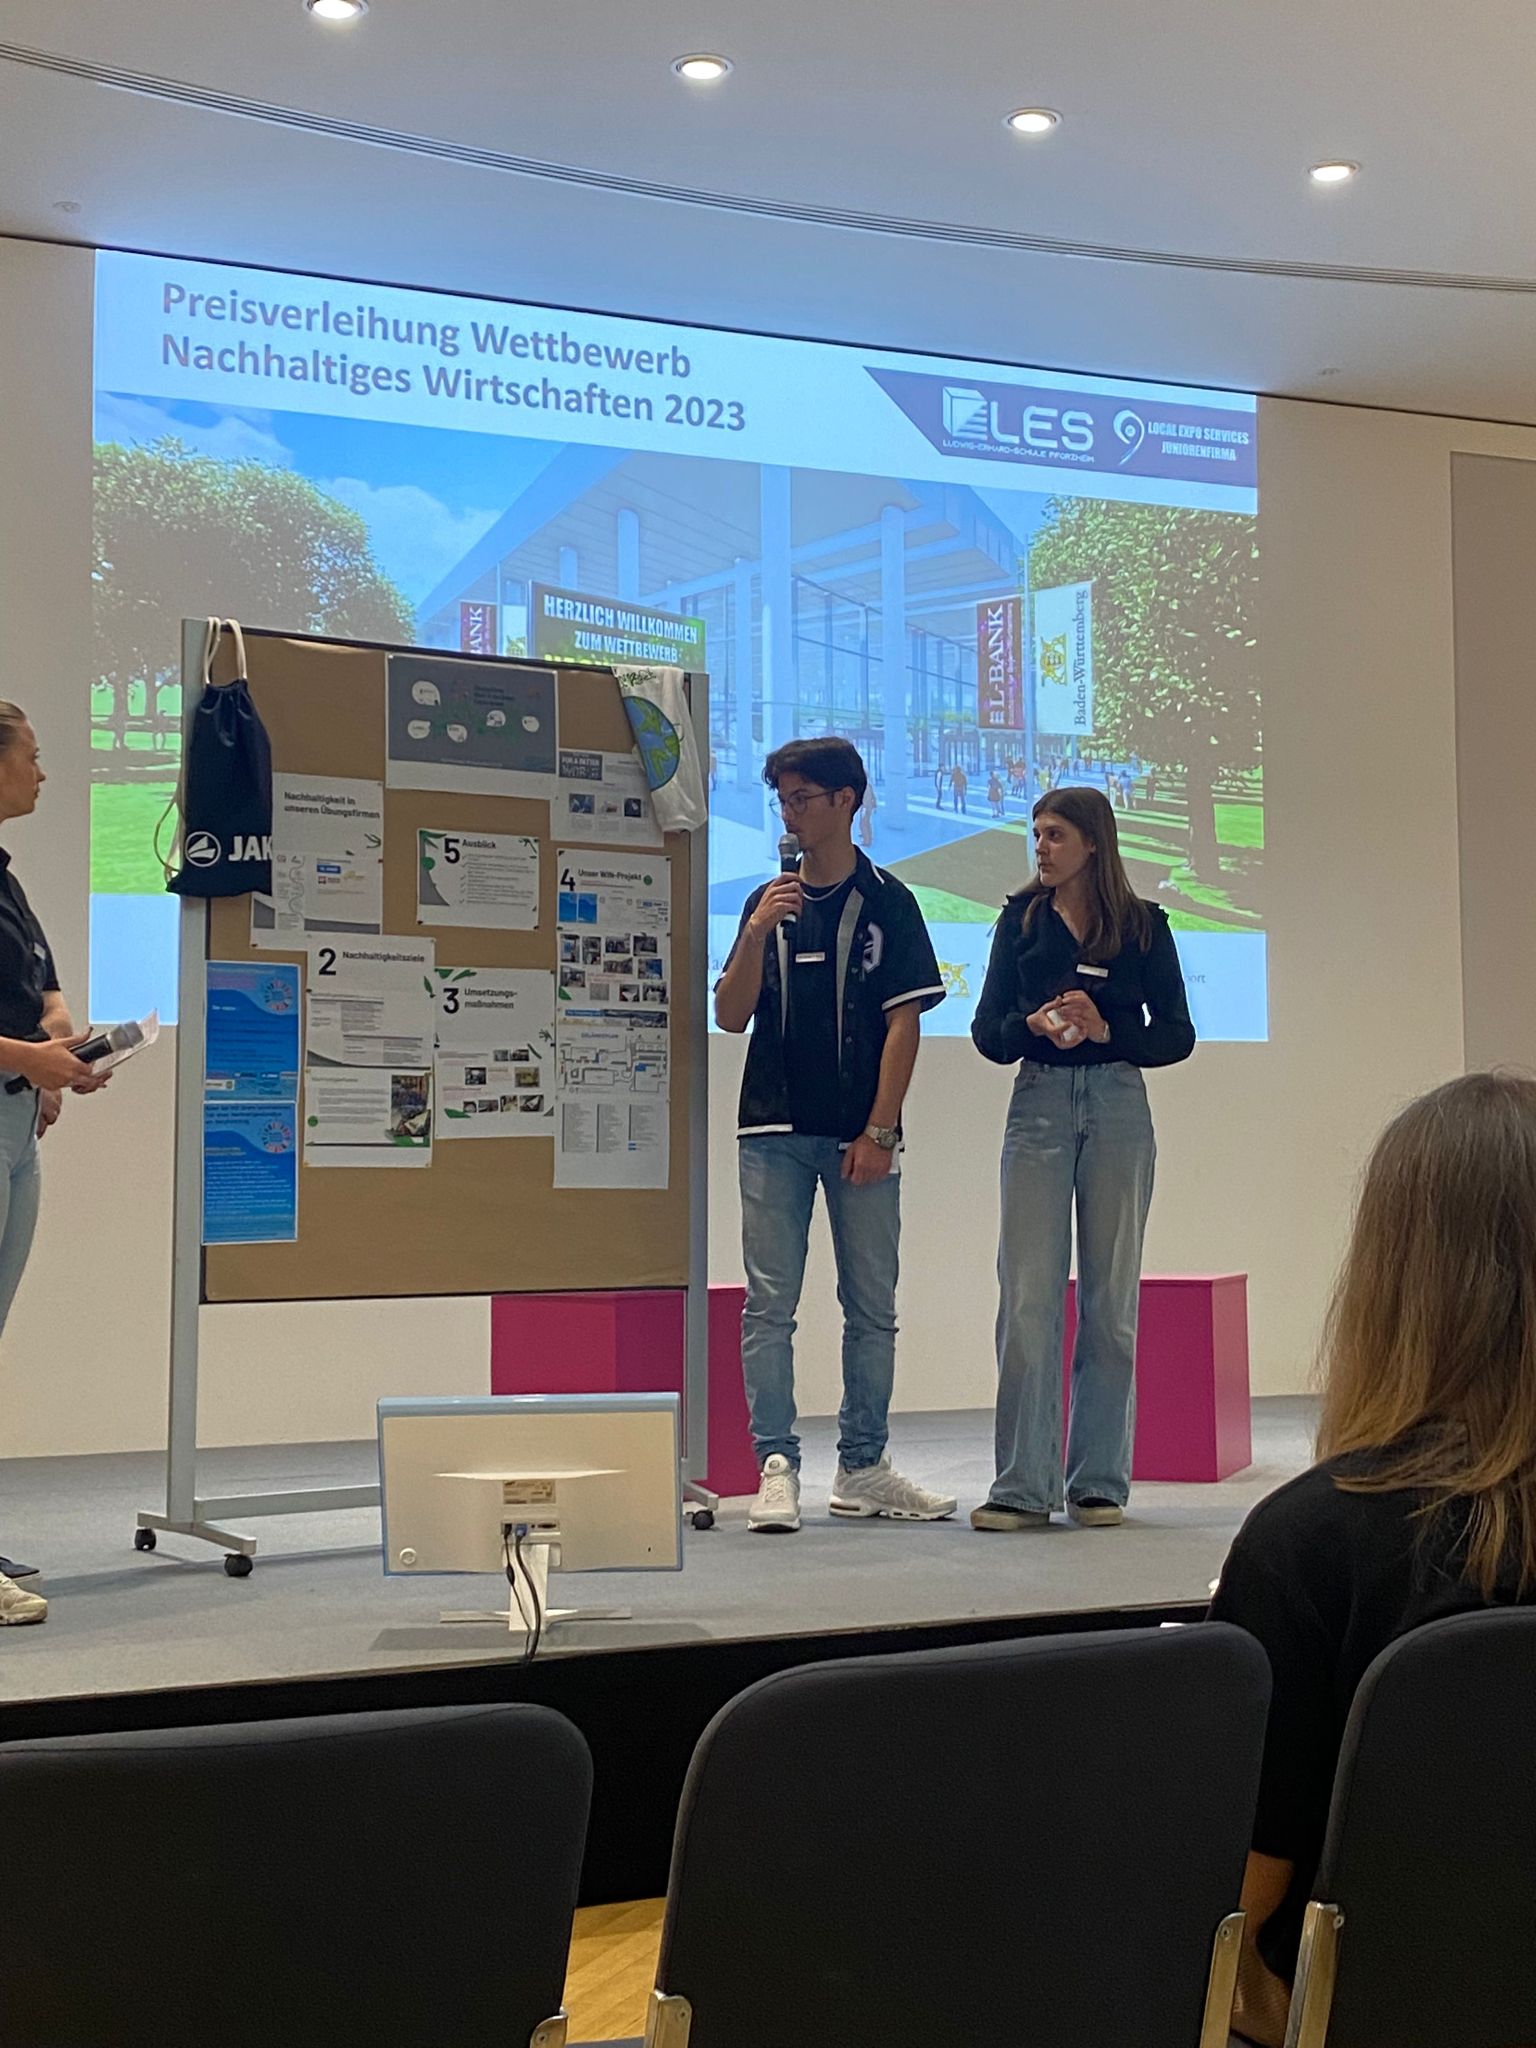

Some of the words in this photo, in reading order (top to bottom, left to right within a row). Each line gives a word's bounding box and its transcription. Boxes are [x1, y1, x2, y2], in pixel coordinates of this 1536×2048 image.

[163, 281, 460, 356] Preisverleihung
[472, 321, 691, 379] Wettbewerb
[163, 333, 411, 395] Nachhaltiges
[423, 364, 653, 421] Wirtschaften
[665, 393, 746, 432] 2023
[989, 401, 1095, 452] LES
[1148, 421, 1178, 438] LOCAL
[1178, 424, 1202, 441] EXPO
[1203, 426, 1249, 445] SERVICES
[1161, 440, 1237, 462] JUNIORENFIRMA
[469, 606, 482, 653] ANK
[543, 594, 615, 628] HERZLICH
[617, 610, 698, 645] WILLKOMMEN
[574, 630, 601, 651] ZUM
[604, 635, 678, 664] WETTBEWERB
[1072, 589, 1089, 727] Baden-Württemberg
[283, 791, 345, 806] Nachhaltigkeit
[347, 797, 356, 805] in
[284, 804, 320, 815] unseren
[321, 804, 380, 819] Übungsfirmen
[444, 838, 460, 864] 5
[462, 838, 497, 850] Ausblick
[560, 868, 576, 892] 4
[578, 869, 599, 878] Unser
[318, 947, 337, 976] 2
[342, 951, 425, 963] Nachhaltigkeitsziele
[443, 987, 460, 1014] 3
[464, 987, 518, 999] Umsetzungs-
[464, 1000, 515, 1010] maßnahmen
